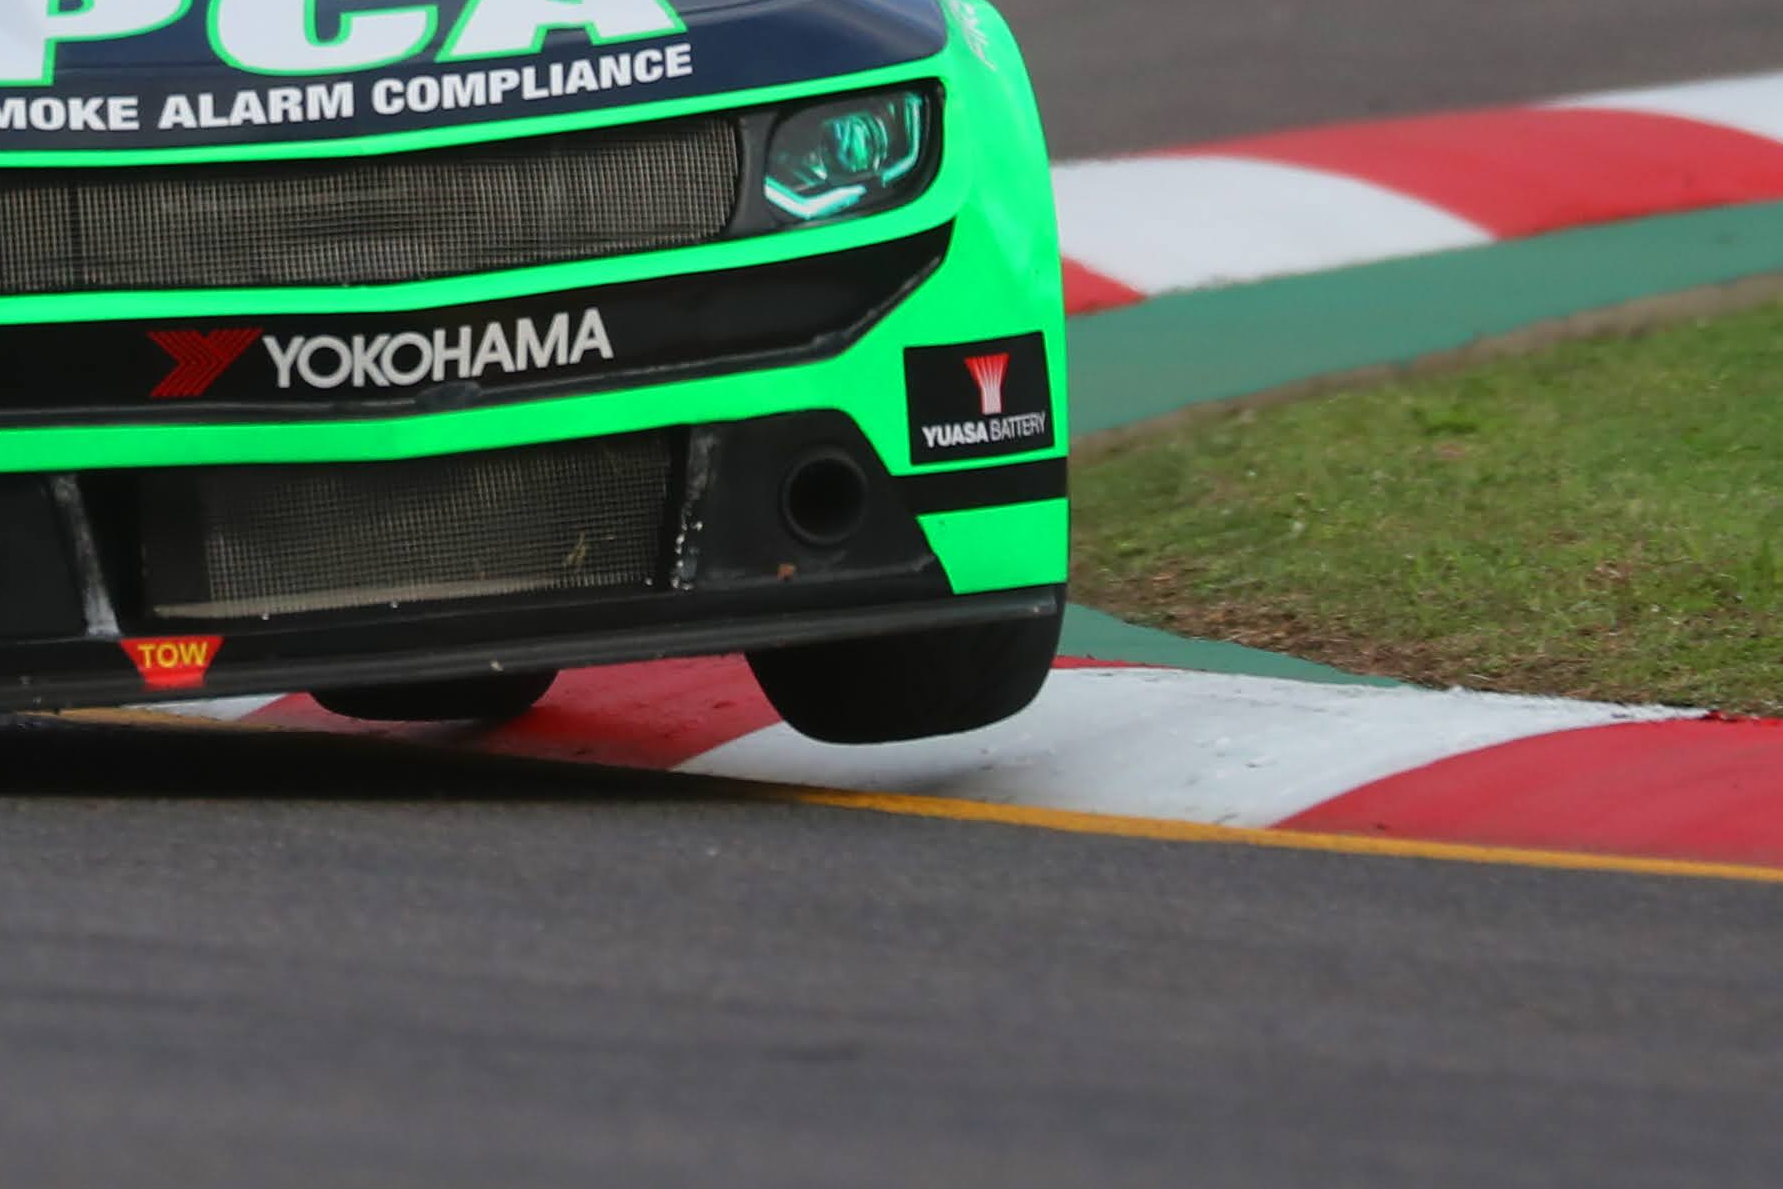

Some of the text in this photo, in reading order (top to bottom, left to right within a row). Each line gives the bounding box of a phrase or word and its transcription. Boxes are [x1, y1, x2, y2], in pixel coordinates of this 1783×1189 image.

[159, 80, 354, 129] ALARM
[371, 43, 693, 115] COMPLIANCE
[262, 308, 615, 389] YOKOHAMA
[921, 409, 1047, 448] YUASA BATTERY
[137, 642, 209, 669] TOW
